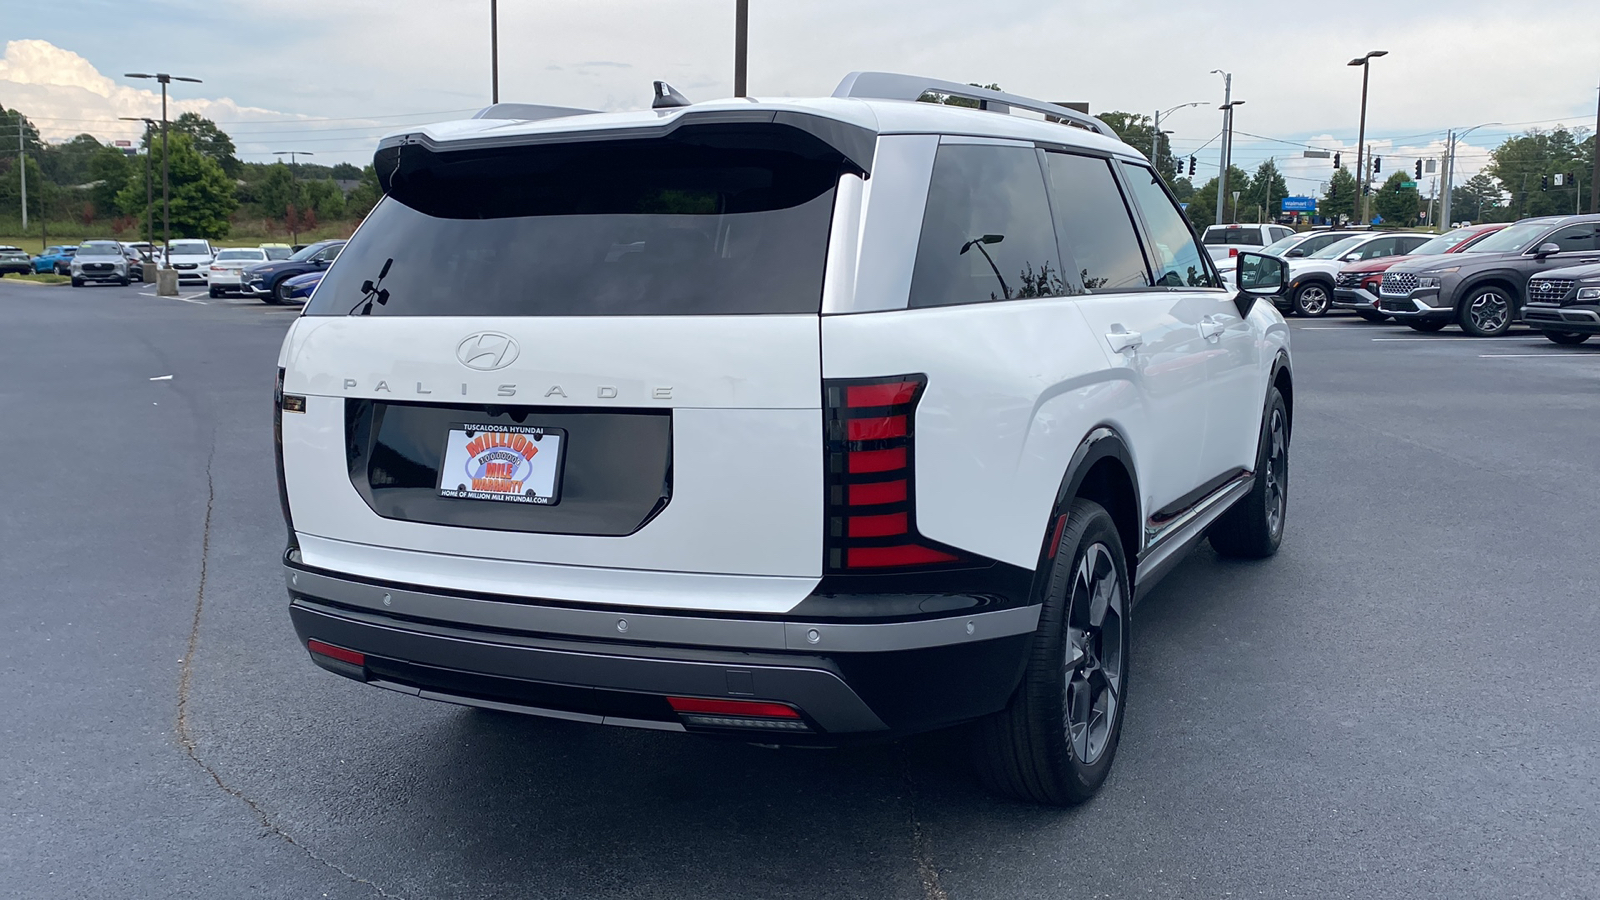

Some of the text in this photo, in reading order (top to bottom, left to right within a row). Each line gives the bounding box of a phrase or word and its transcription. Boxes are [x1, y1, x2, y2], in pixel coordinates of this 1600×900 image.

[343, 378, 674, 400] PALISADE
[464, 424, 543, 434] TUSCALOOSA HYUNDAI
[466, 432, 538, 461] MILLION
[485, 463, 513, 480] MILE
[472, 478, 524, 494] WARRANTY
[505, 495, 548, 504] HYUNDAI.COM
